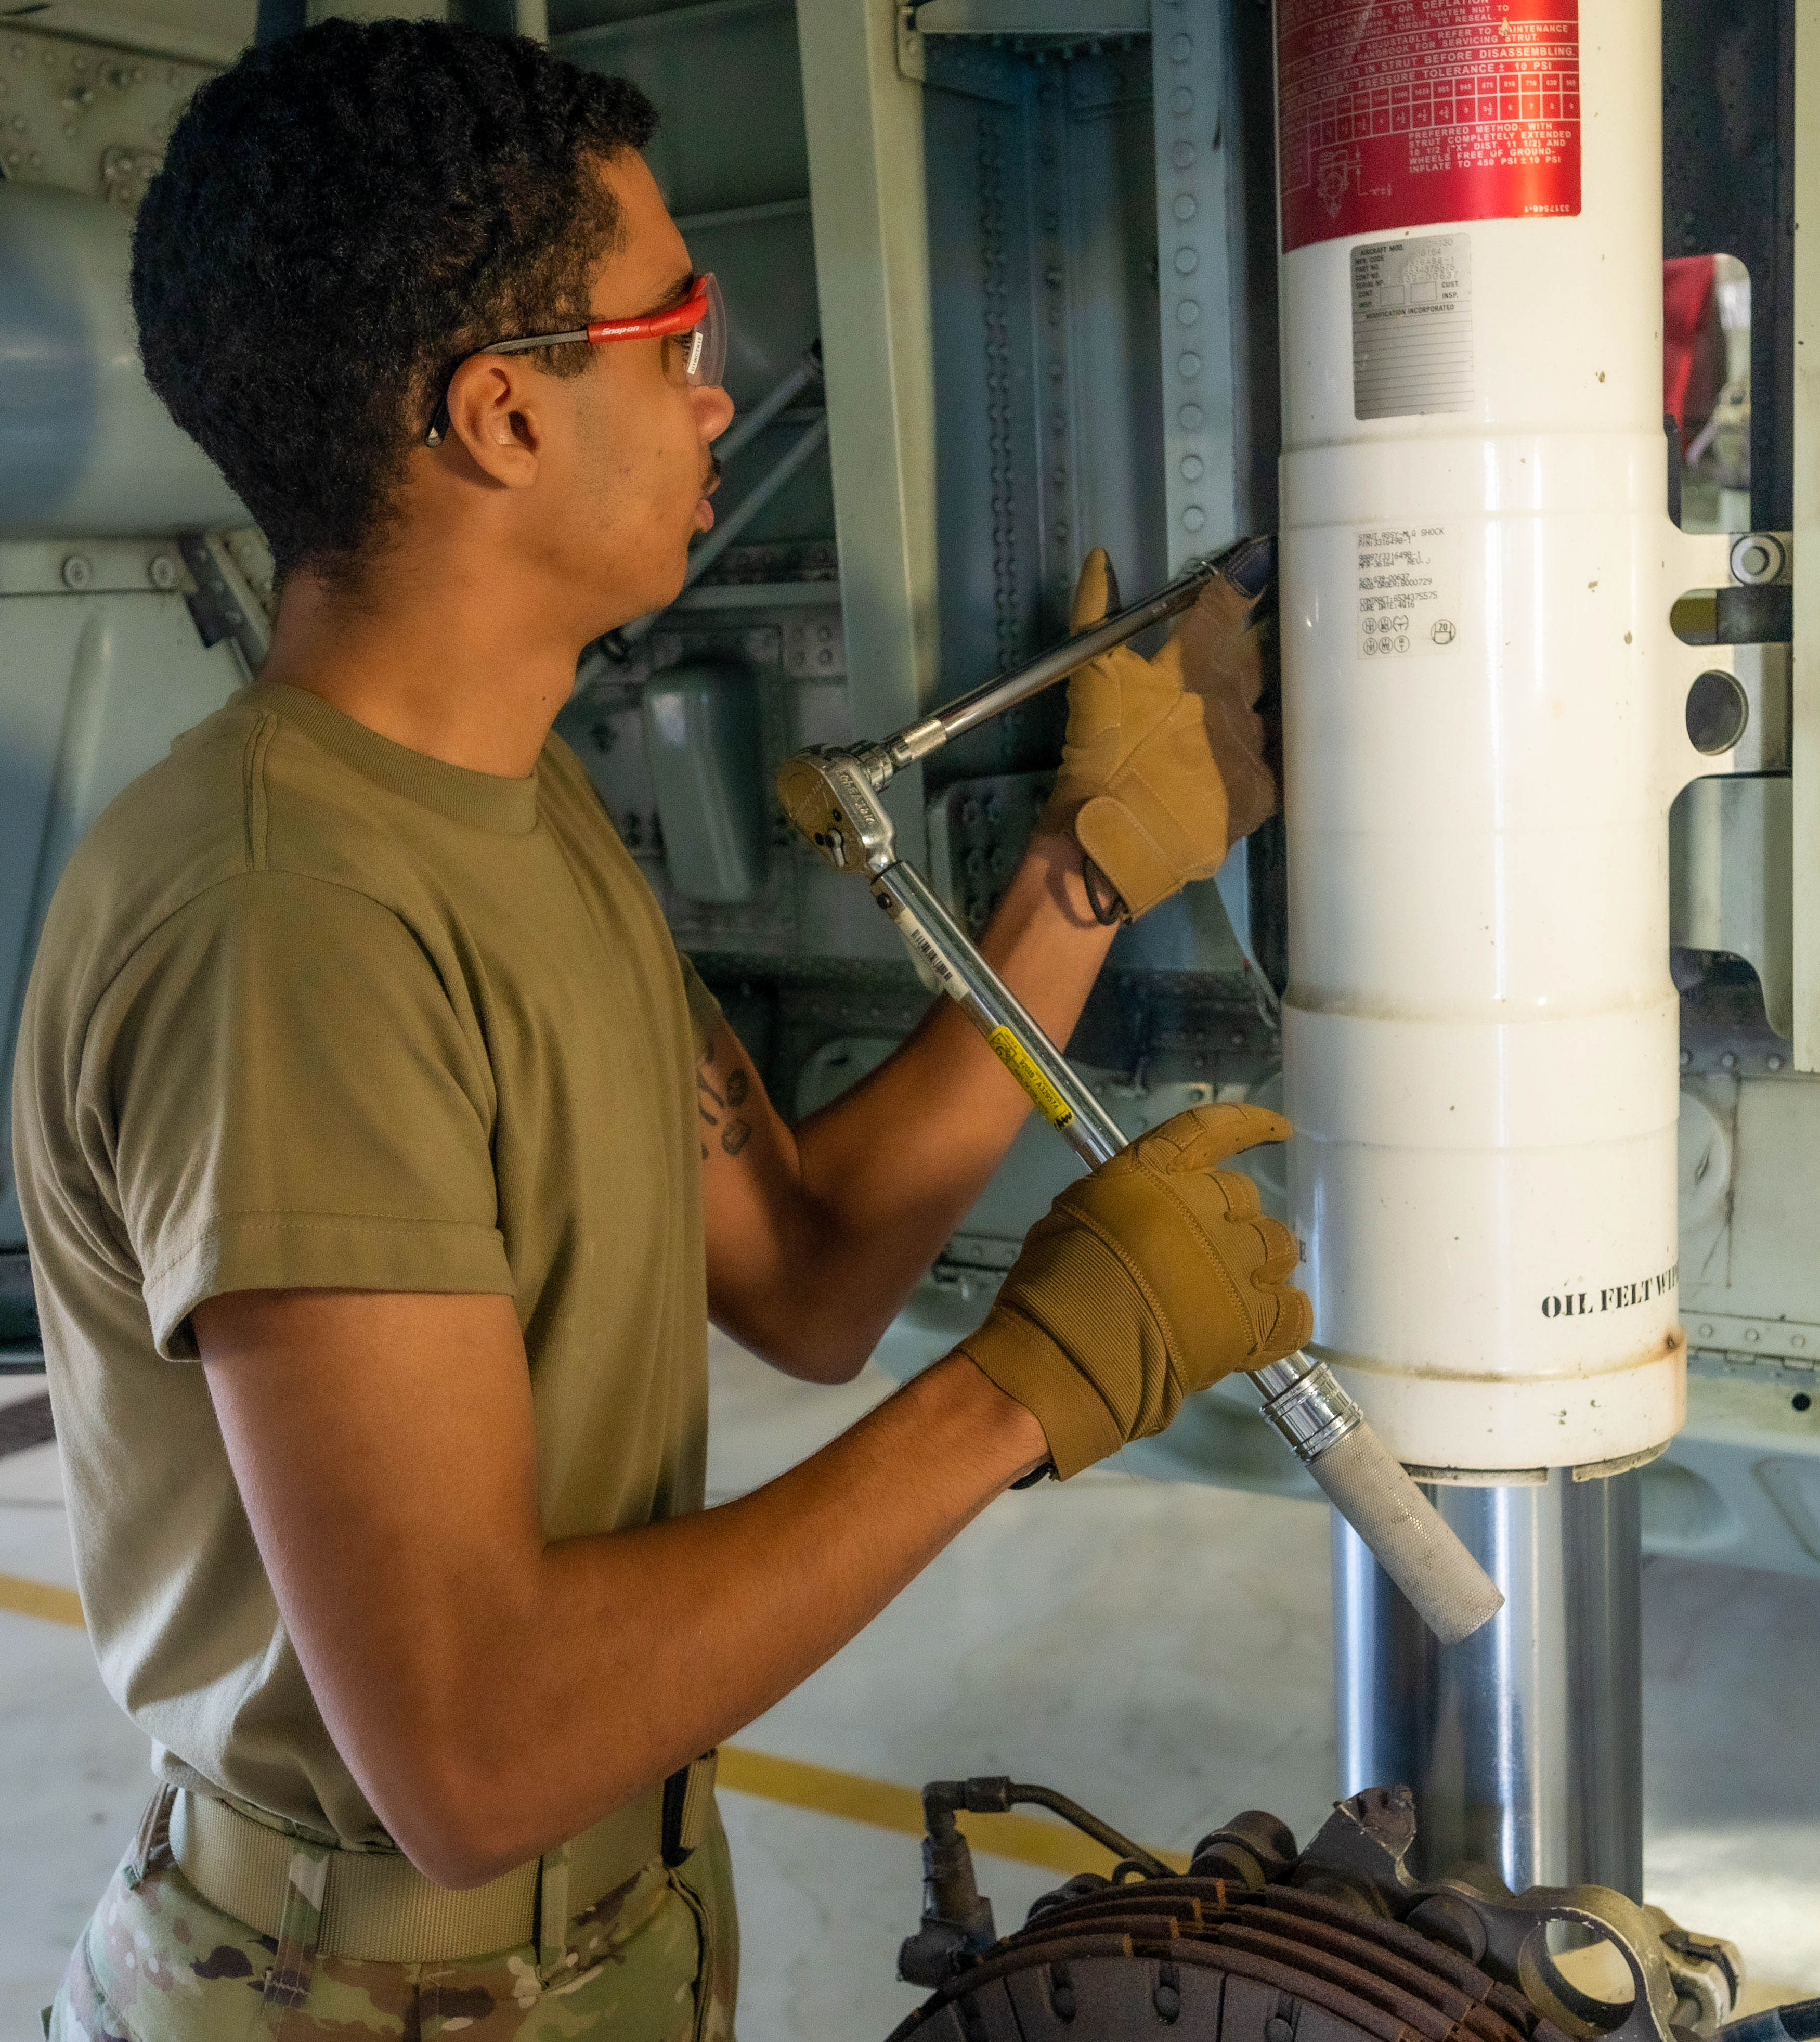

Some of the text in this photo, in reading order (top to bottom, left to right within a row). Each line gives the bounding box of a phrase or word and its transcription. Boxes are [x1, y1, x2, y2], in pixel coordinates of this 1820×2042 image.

[1391, 4, 1414, 14] FOR
[1425, 7, 1466, 18] TIGHTEN
[1472, 5, 1490, 14] NUT
[1455, 14, 1496, 23] RESEAL.
[1438, 29, 1472, 40] REFER
[1357, 34, 1539, 61] HANDBOOK FOR SERVICING STRUT.
[1344, 68, 1360, 77] AIR
[1364, 66, 1376, 74] IN
[1381, 57, 1418, 71] STRUT
[1424, 51, 1473, 64] BEFORE
[1479, 47, 1575, 59] DISASSEMBLING.
[1358, 72, 1416, 88] PRESSURE
[1423, 64, 1495, 79] TOLERANCE
[1515, 62, 1527, 71] 10
[1533, 61, 1552, 70] PSI
[1409, 126, 1470, 140] PREFERRED
[1409, 131, 1572, 149] STRUT COMPLETELY EXTENDED
[1474, 141, 1500, 150] DIST.
[1524, 139, 1541, 148] 1/2)
[1409, 147, 1556, 165] WHEELS FREE OF GROUND-
[1409, 162, 1451, 174] INFLATE
[1458, 160, 1472, 169] TO
[1477, 158, 1494, 166] 450
[1501, 157, 1518, 165] PSI
[1529, 156, 1540, 164] 10
[1545, 156, 1561, 164] PSI
[1360, 246, 1387, 256] AIRCRAFT
[1355, 281, 1374, 289] SERIAL
[1441, 280, 1460, 289] CUST.
[1366, 304, 1455, 319] MODIFICATION INCORPORATED
[601, 326, 640, 335] Snap-on
[1358, 532, 1378, 540] STRUT
[1421, 527, 1445, 537] SHOCK
[1425, 557, 1431, 565] J
[1438, 622, 1448, 631] 70
[1542, 1292, 1593, 1318] OIL
[1600, 1277, 1653, 1311] FELT
